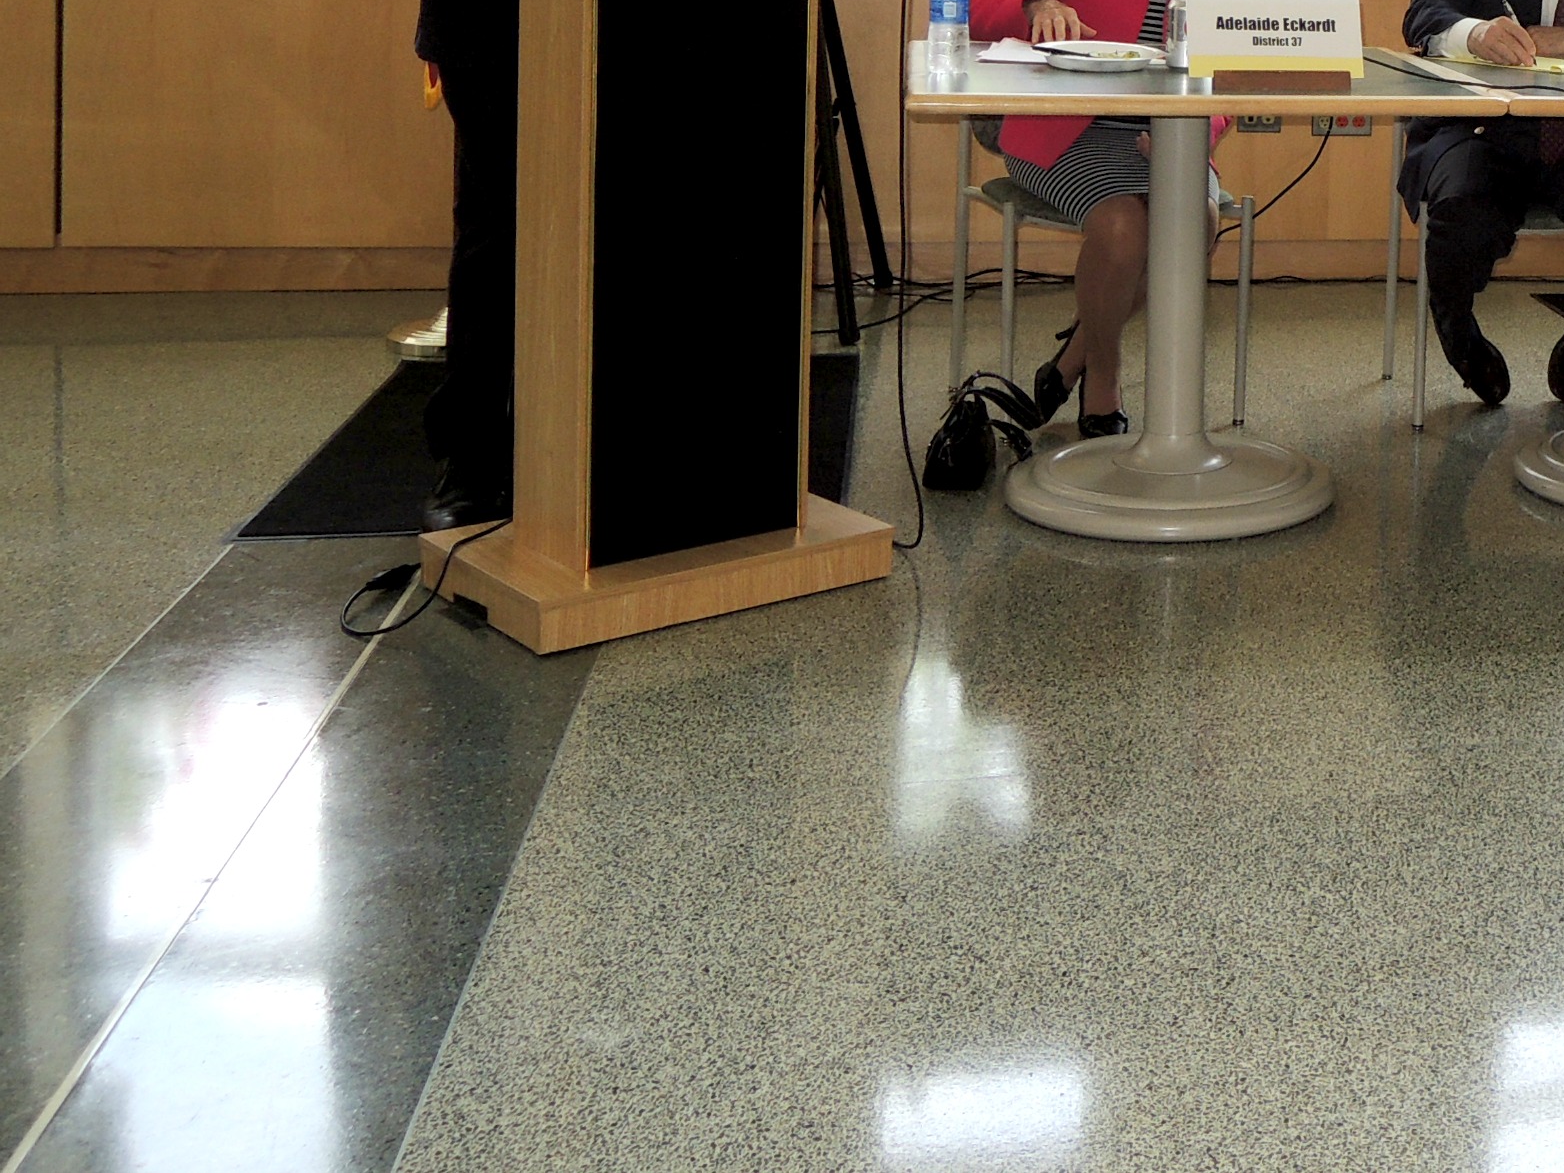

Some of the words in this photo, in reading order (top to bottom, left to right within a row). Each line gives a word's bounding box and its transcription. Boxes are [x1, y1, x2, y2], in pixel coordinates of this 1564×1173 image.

[1216, 16, 1280, 31] Adelaide
[1283, 17, 1336, 33] Eckardt
[1252, 36, 1289, 47] District
[1291, 36, 1302, 47] 37
